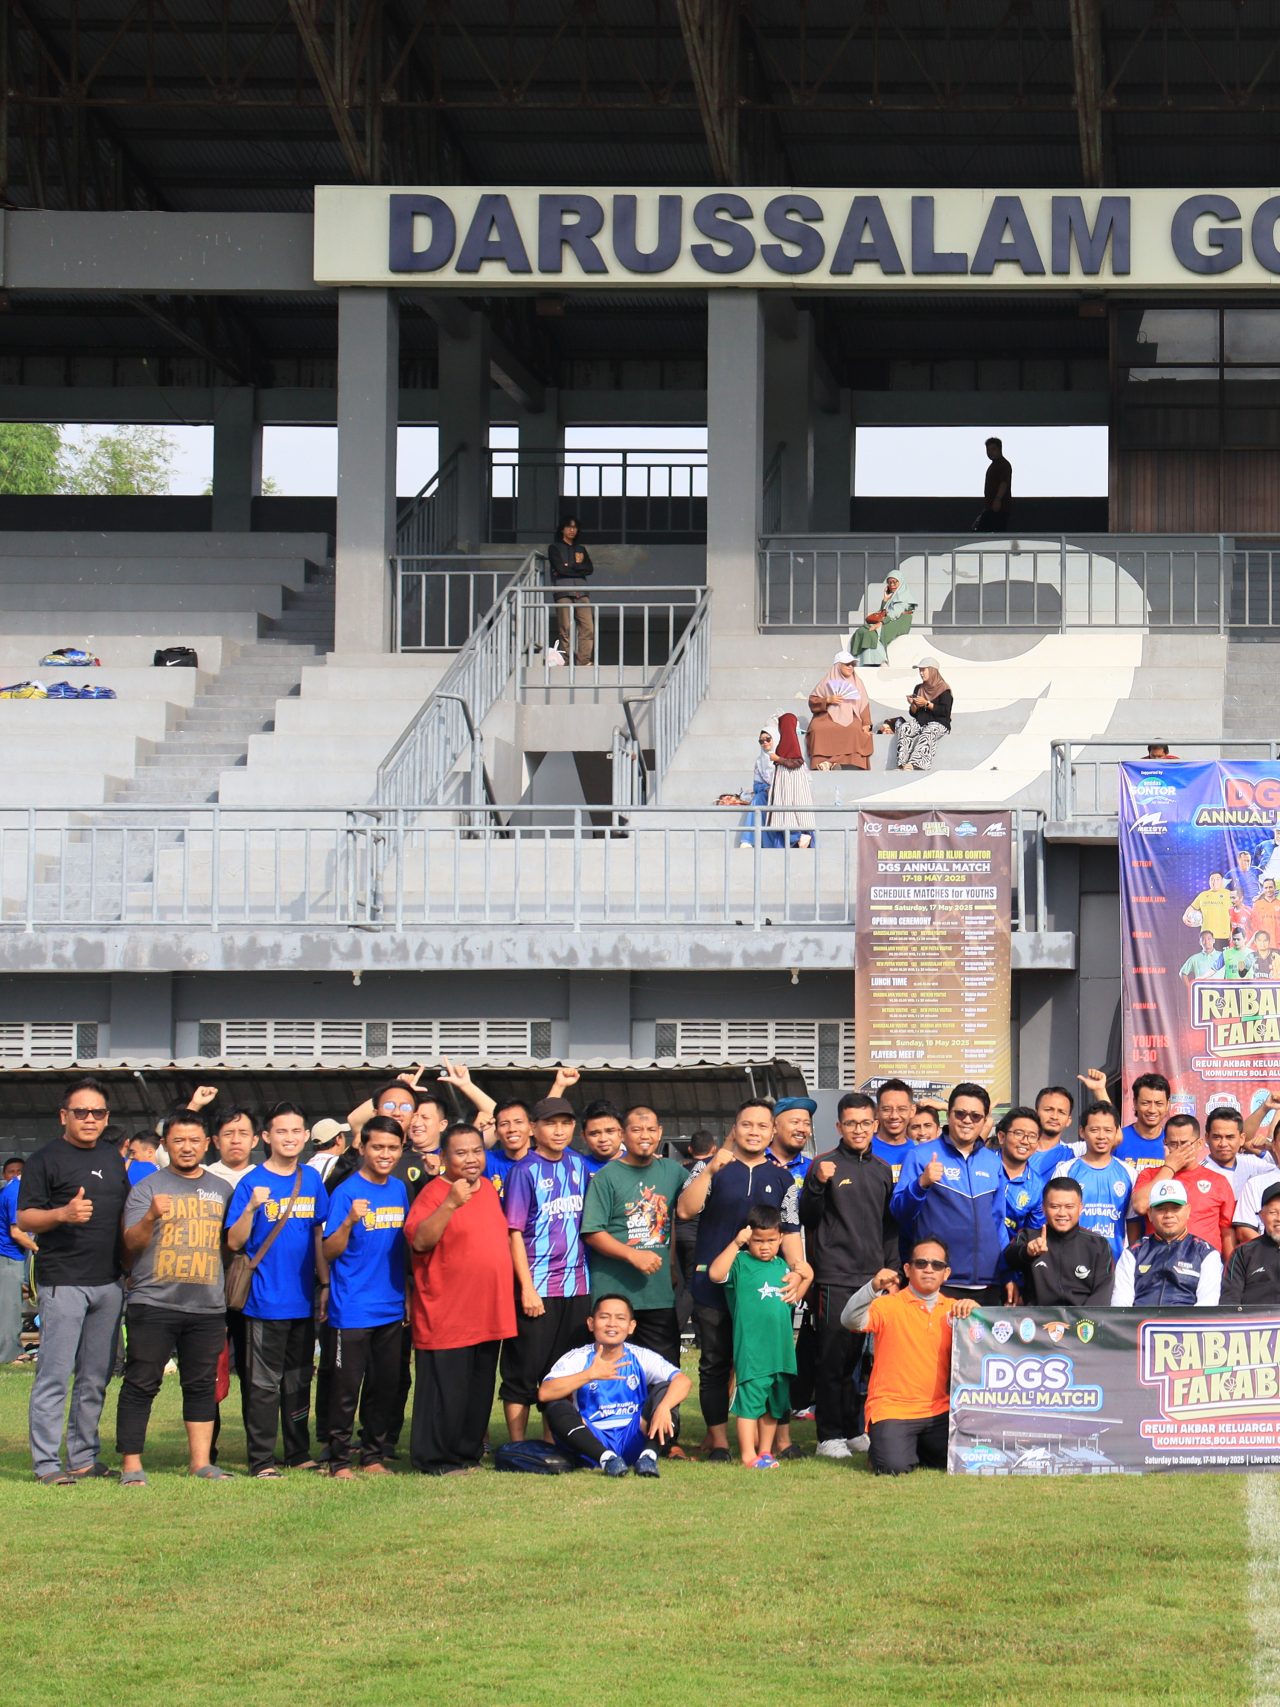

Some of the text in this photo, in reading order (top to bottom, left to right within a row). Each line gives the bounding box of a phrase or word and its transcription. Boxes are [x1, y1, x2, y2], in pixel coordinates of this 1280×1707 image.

[388, 193, 1131, 276] DARUSSALAM
[1199, 811, 1272, 824] ANNUAL
[877, 850, 991, 859] REUNI AKBAR ANTAR KLUB GONTOR
[878, 863, 991, 872] DGS ANNUAL MATCH
[873, 888, 994, 899] SCHEDULE MATCHES for YOUTHS
[872, 917, 897, 925] OPENING
[898, 917, 931, 925] CEREMONY
[871, 977, 908, 986] LUNCH TIME
[896, 1039, 925, 1047] Sunday,
[1133, 1035, 1169, 1047] YOUTHS
[871, 1050, 897, 1059] PLAYERS
[899, 1050, 915, 1059] MEET
[916, 1050, 925, 1059] UP
[1133, 1050, 1157, 1062] U-30
[1196, 1060, 1221, 1068] REUNI
[1223, 1060, 1251, 1068] AKBAR
[163, 1197, 209, 1221] DARE
[162, 1223, 184, 1248] BE
[156, 1249, 218, 1282] RENT
[988, 1360, 1067, 1389] DGS
[958, 1390, 1097, 1406] ANNUAL MATCH
[1145, 1424, 1178, 1434] REUNI
[1180, 1424, 1216, 1434] AKBAR
[1218, 1423, 1273, 1433] KELUARGA
[1213, 1436, 1238, 1445] BOLA
[1239, 1436, 1276, 1445] ALUMNI
[962, 1453, 1001, 1462] GONTOR
[1145, 1456, 1171, 1465] Saturday
[1172, 1456, 1179, 1464] to
[1179, 1456, 1202, 1466] Sunday,
[1203, 1456, 1216, 1464] 17-18
[1217, 1456, 1229, 1465] May
[1230, 1456, 1245, 1464] 2025
[1251, 1455, 1263, 1464] Live
